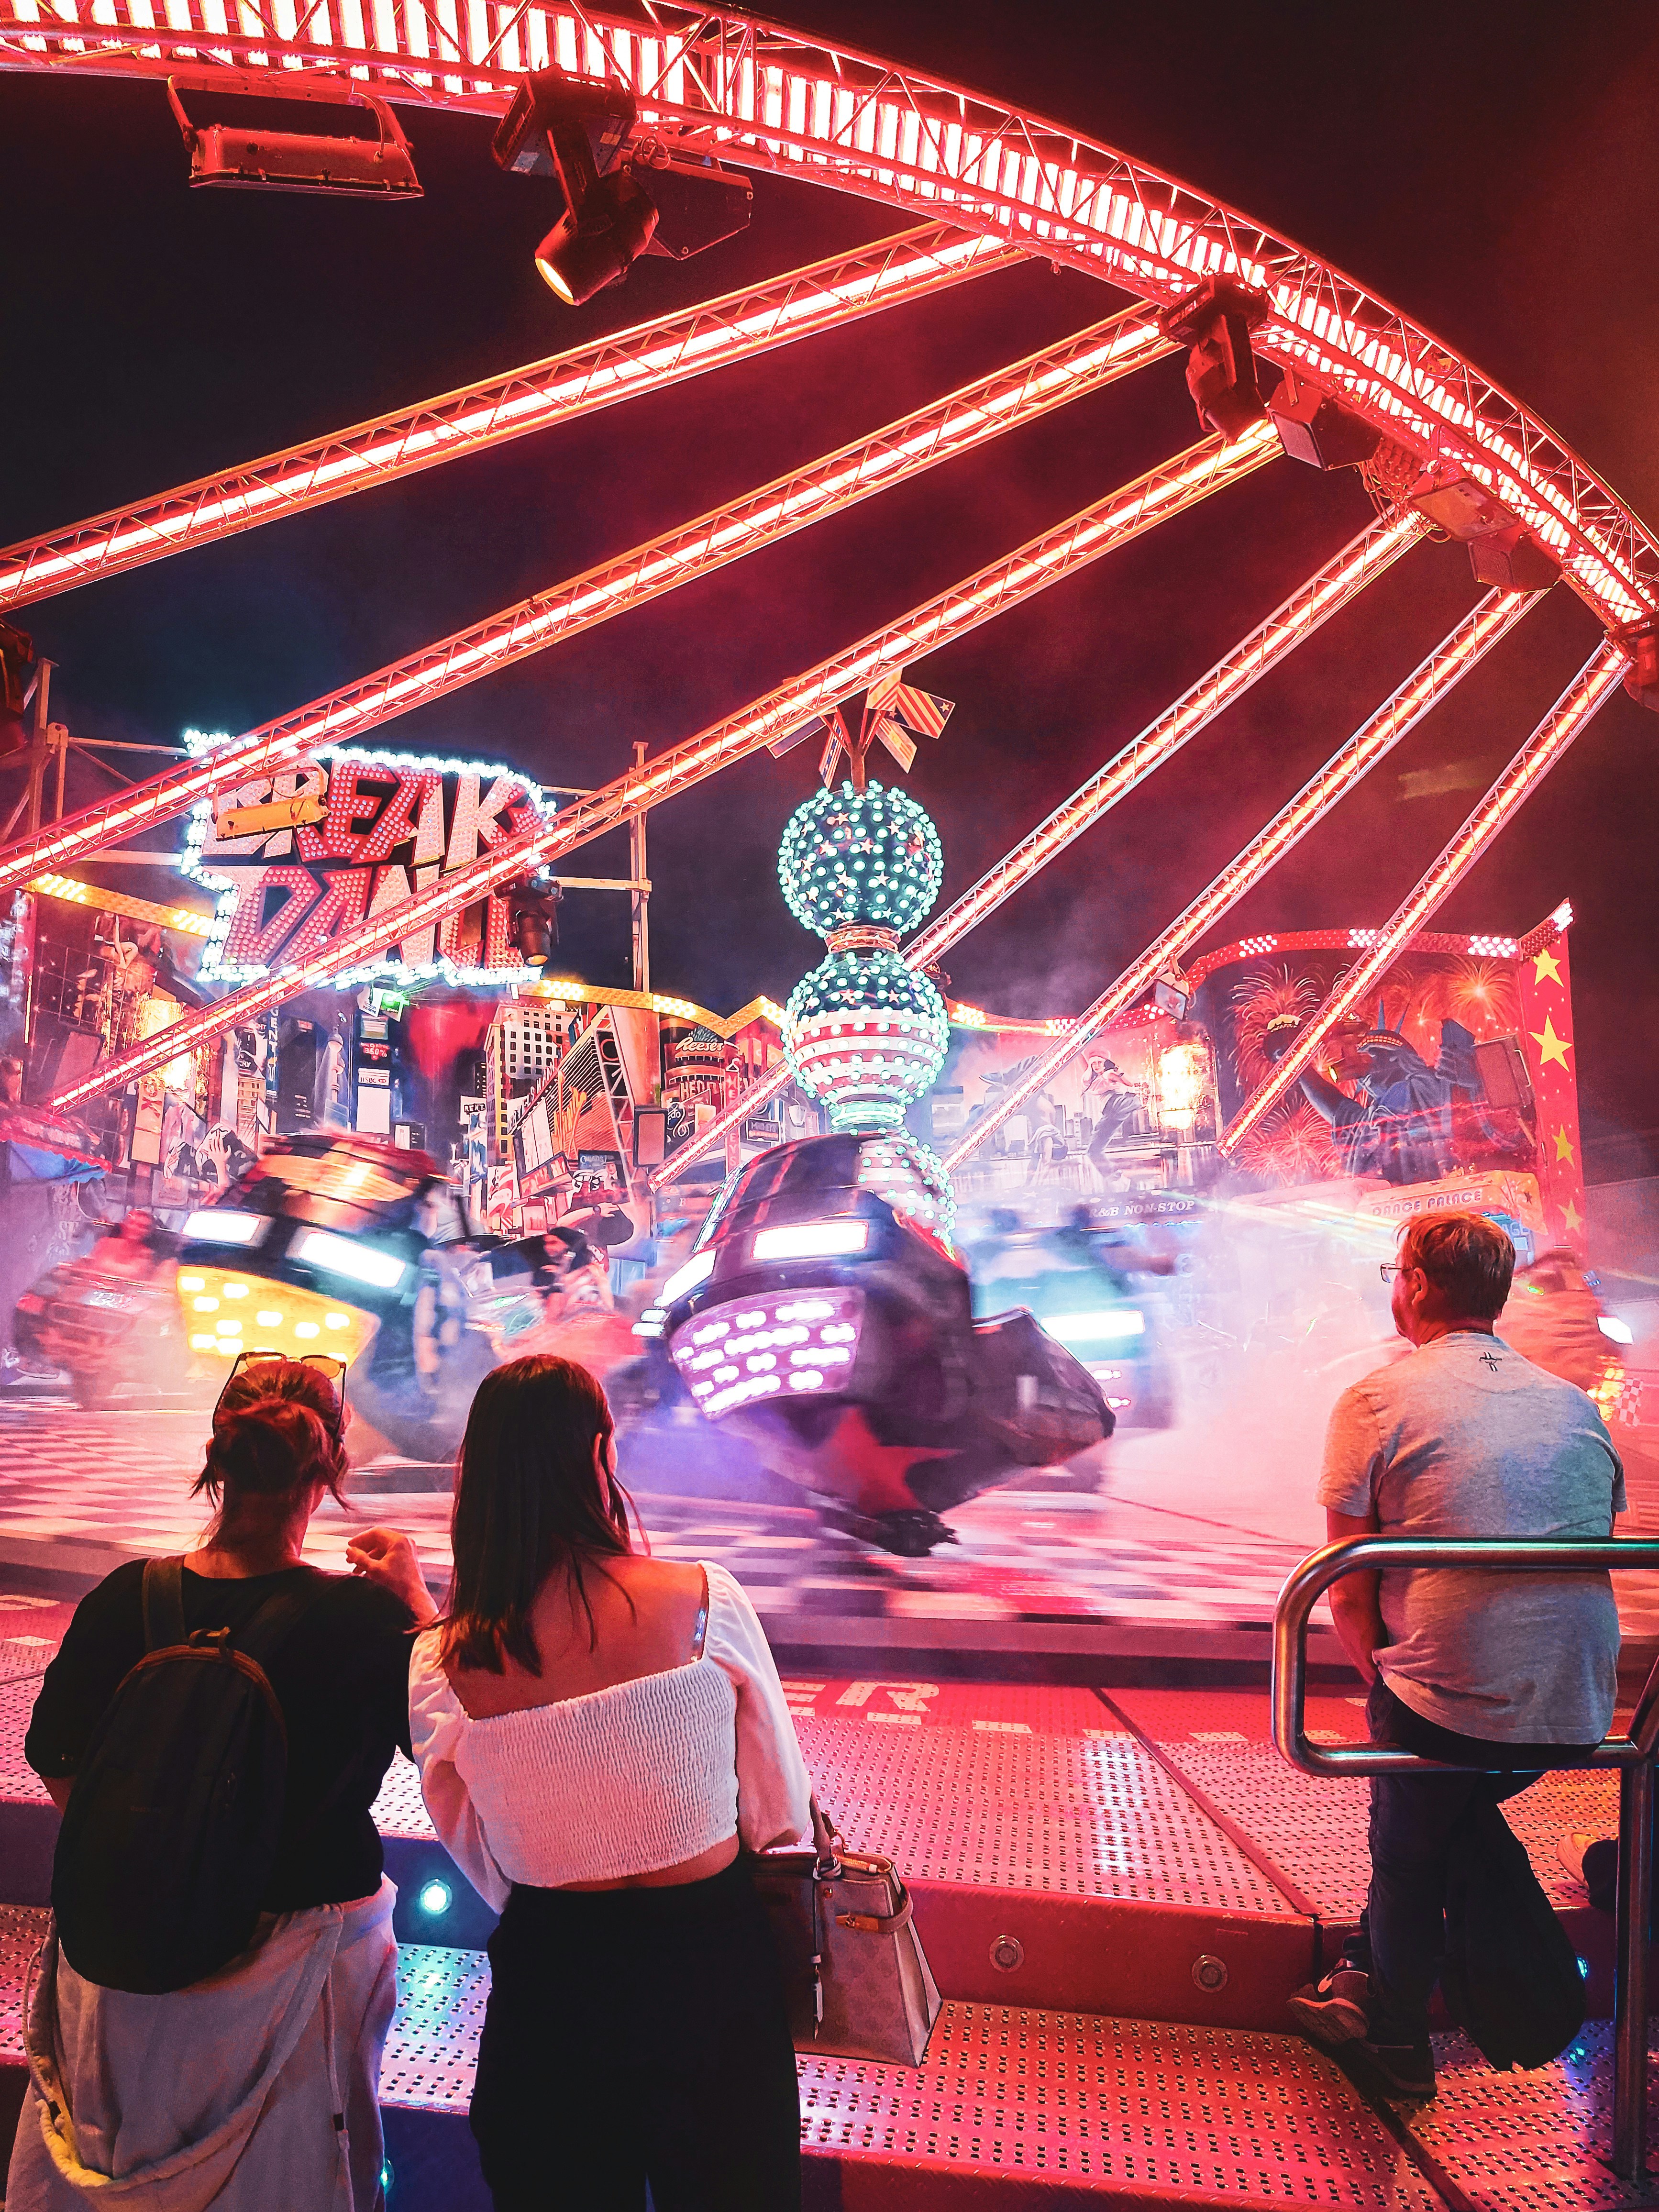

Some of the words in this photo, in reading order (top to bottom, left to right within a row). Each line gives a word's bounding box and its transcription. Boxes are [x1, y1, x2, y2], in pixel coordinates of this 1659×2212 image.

[1090, 1206, 1119, 1217] R&B
[1124, 1200, 1195, 1216] NON-STOP
[1372, 1200, 1420, 1216] DANCE
[1428, 1191, 1481, 1209] PALACE
